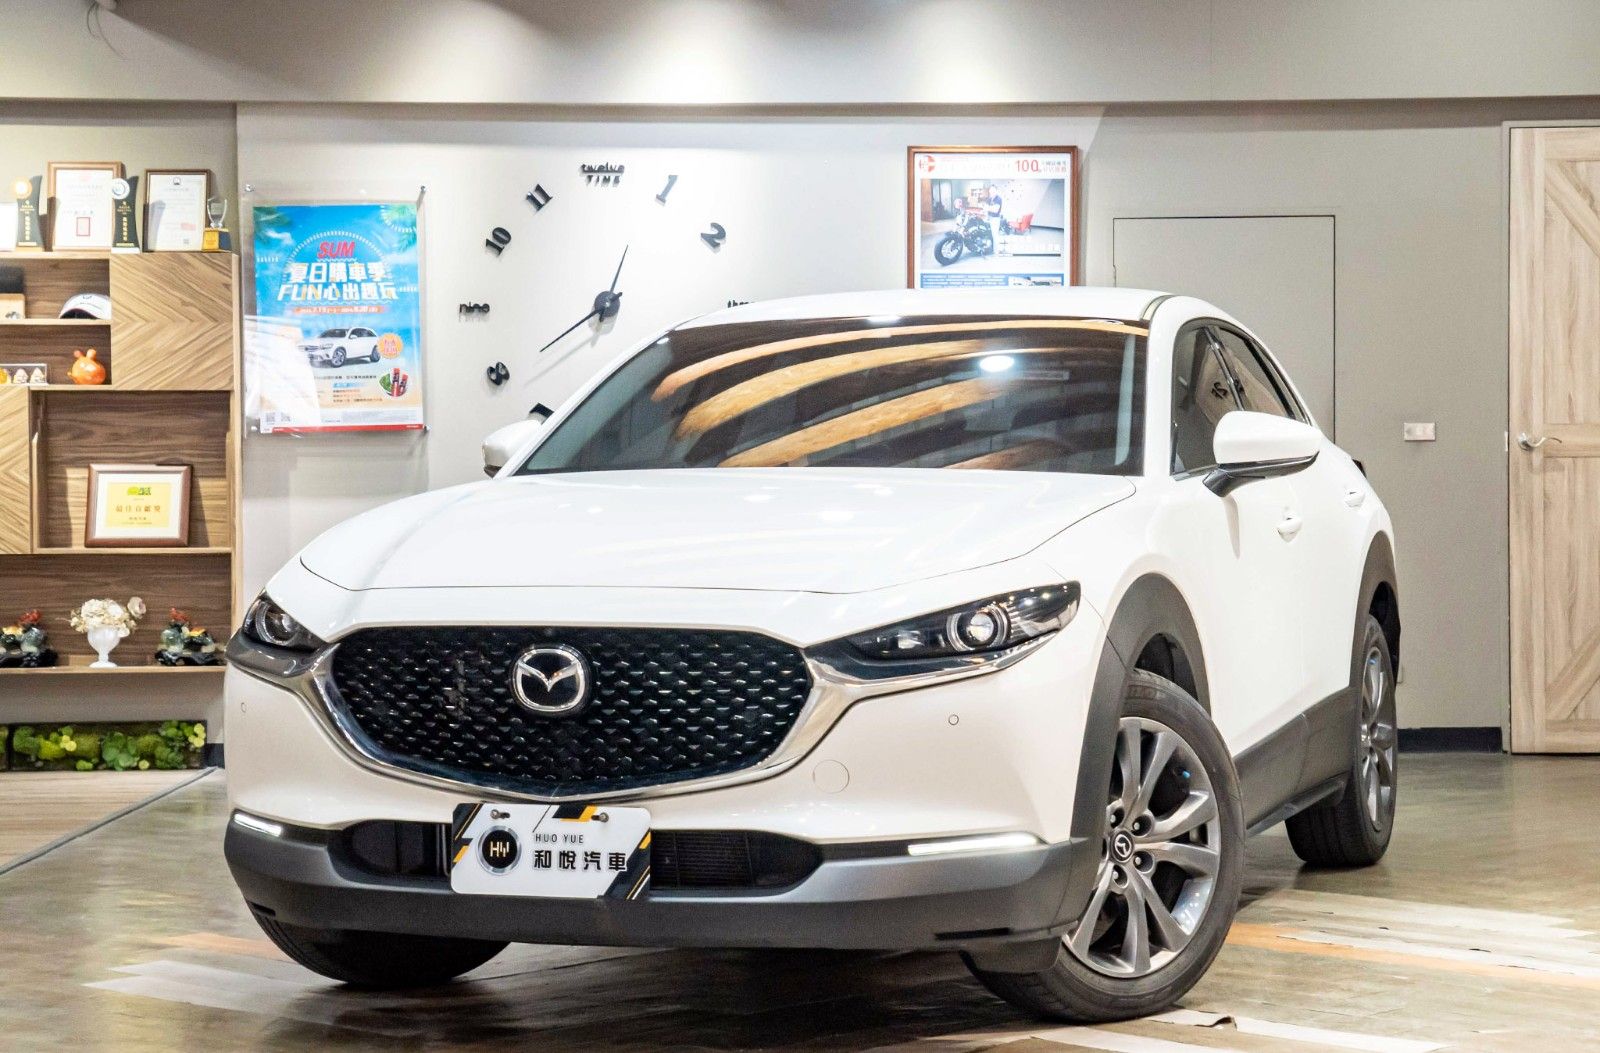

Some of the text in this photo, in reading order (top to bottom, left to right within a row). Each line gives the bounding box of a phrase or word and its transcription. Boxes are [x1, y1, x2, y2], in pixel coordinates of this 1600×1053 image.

[580, 162, 625, 174] twelve
[526, 184, 553, 211] 11
[656, 174, 678, 204] 1
[485, 227, 512, 255] 10
[700, 222, 726, 249] 2
[317, 240, 355, 259] SUM
[459, 301, 490, 313] nine
[487, 362, 510, 386] 8
[535, 833, 585, 844] HUO YUE
[533, 850, 627, 872] 和悅汽車
